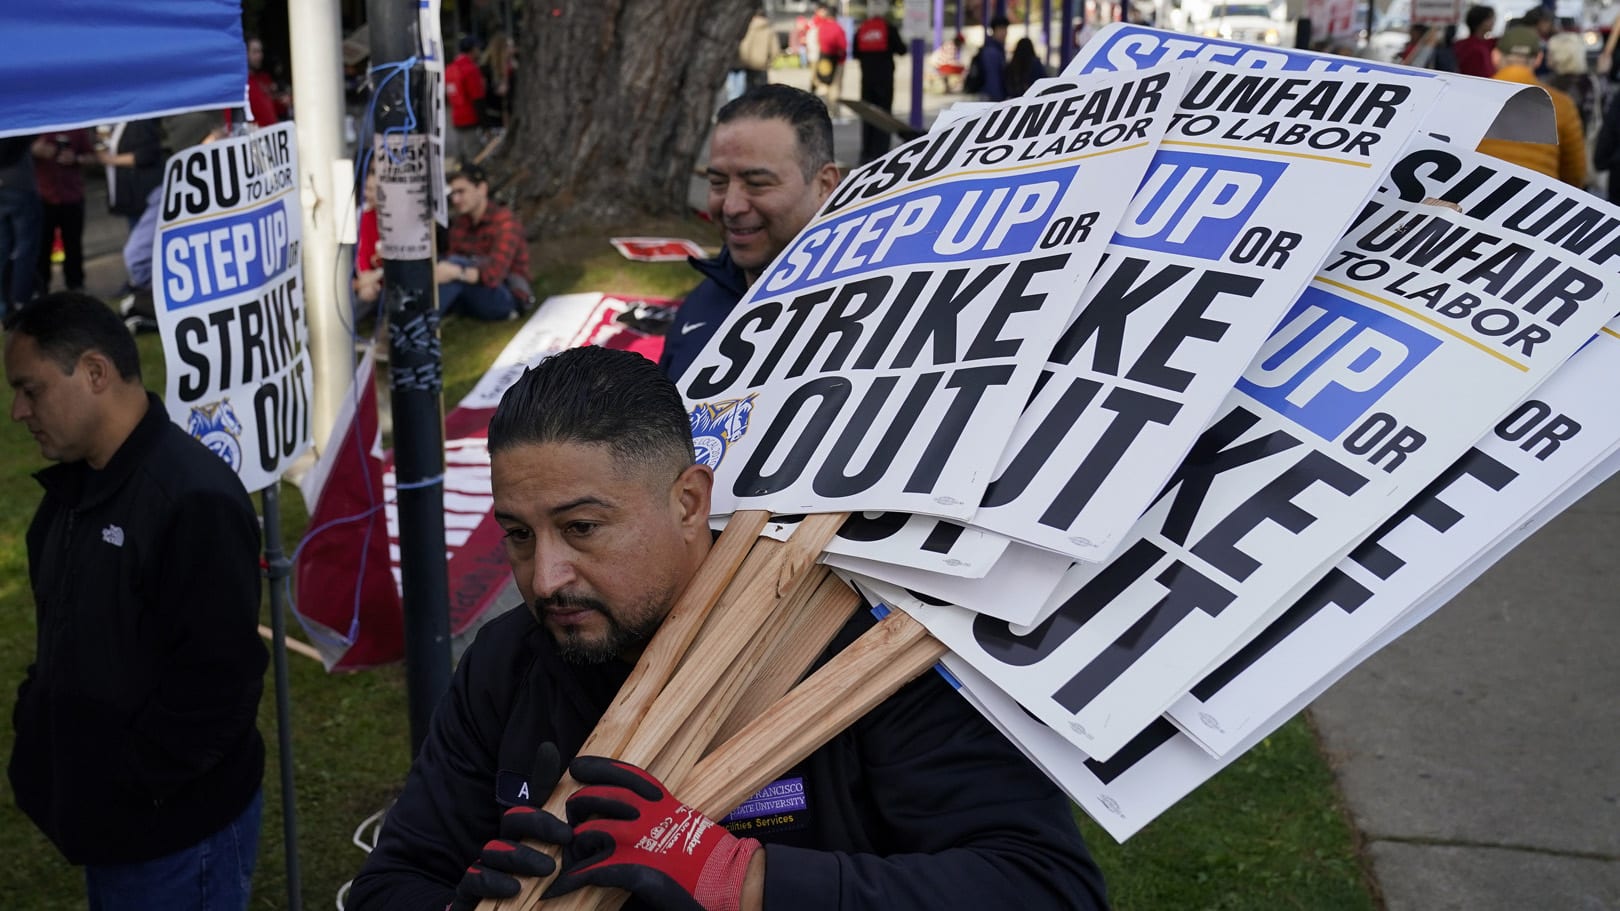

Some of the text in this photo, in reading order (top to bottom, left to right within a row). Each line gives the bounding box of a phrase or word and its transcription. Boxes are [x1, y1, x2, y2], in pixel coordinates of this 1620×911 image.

[975, 71, 1171, 144] UNFAIR
[1165, 112, 1381, 156] TO LABOR
[1179, 71, 1412, 129] UNFAIR
[820, 117, 981, 217] CSU
[961, 117, 1153, 168] TO LABOR
[163, 145, 241, 222] CSU
[246, 180, 262, 202] TO
[1115, 163, 1263, 244] UP
[1379, 149, 1531, 221] SU
[166, 209, 287, 303] STEP UP
[766, 180, 1060, 292] STEP UP
[1040, 211, 1100, 250] OR
[1229, 226, 1303, 270] OR
[1356, 210, 1603, 326] UNFAIR
[175, 277, 301, 403] STRIKE
[686, 253, 1072, 400] STRIKE
[1324, 250, 1551, 357] TO LABOR
[1240, 304, 1409, 408] UP
[254, 359, 308, 472] OUT
[732, 364, 1018, 498] OUT
[979, 370, 1184, 532] UT
[1342, 412, 1427, 474] OR
[1494, 400, 1582, 461] OR
[973, 537, 1238, 715] UT
[725, 815, 794, 832] cilities Services
[755, 796, 805, 812] UNIVERSITY
